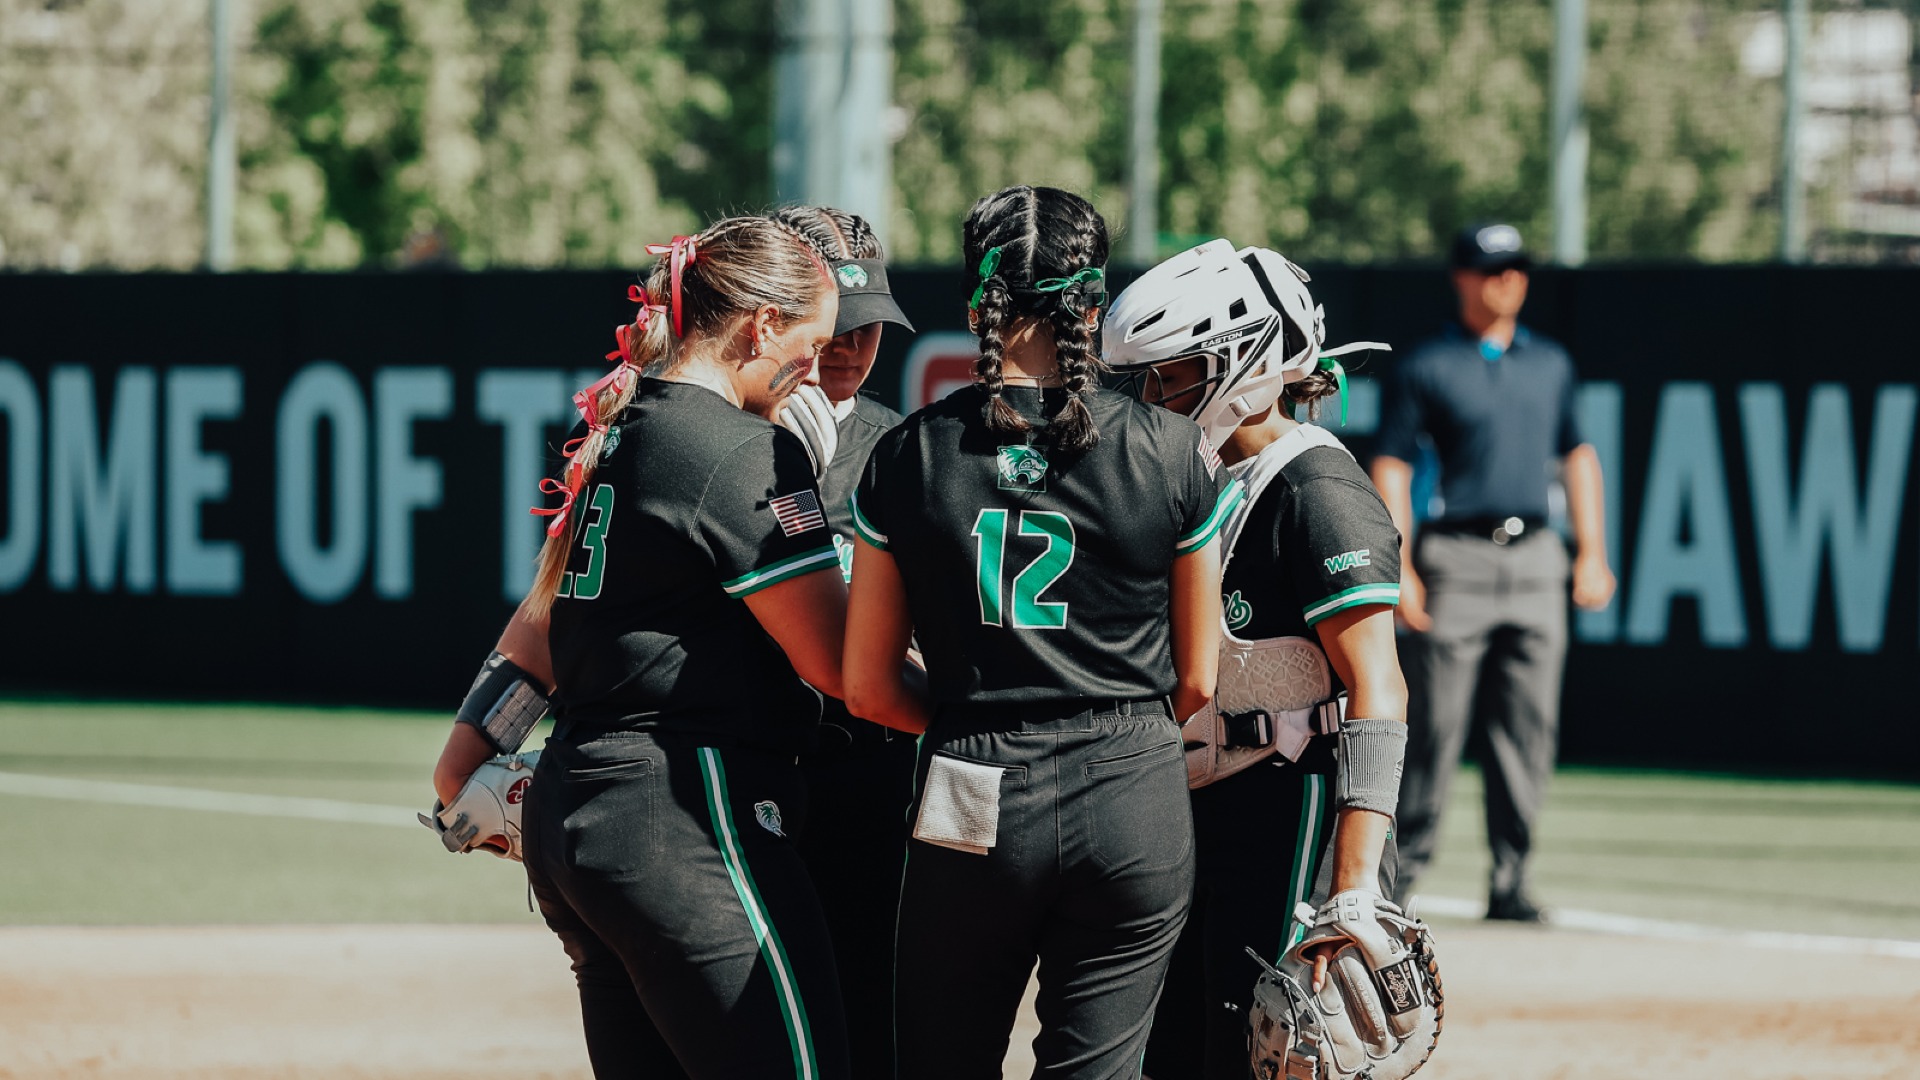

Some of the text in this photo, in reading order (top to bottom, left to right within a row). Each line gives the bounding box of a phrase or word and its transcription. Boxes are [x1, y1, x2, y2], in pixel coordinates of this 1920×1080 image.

[1201, 331, 1243, 349] EASTON
[275, 361, 454, 603] OF
[971, 508, 1076, 629] 12
[1324, 548, 1371, 575] WAC
